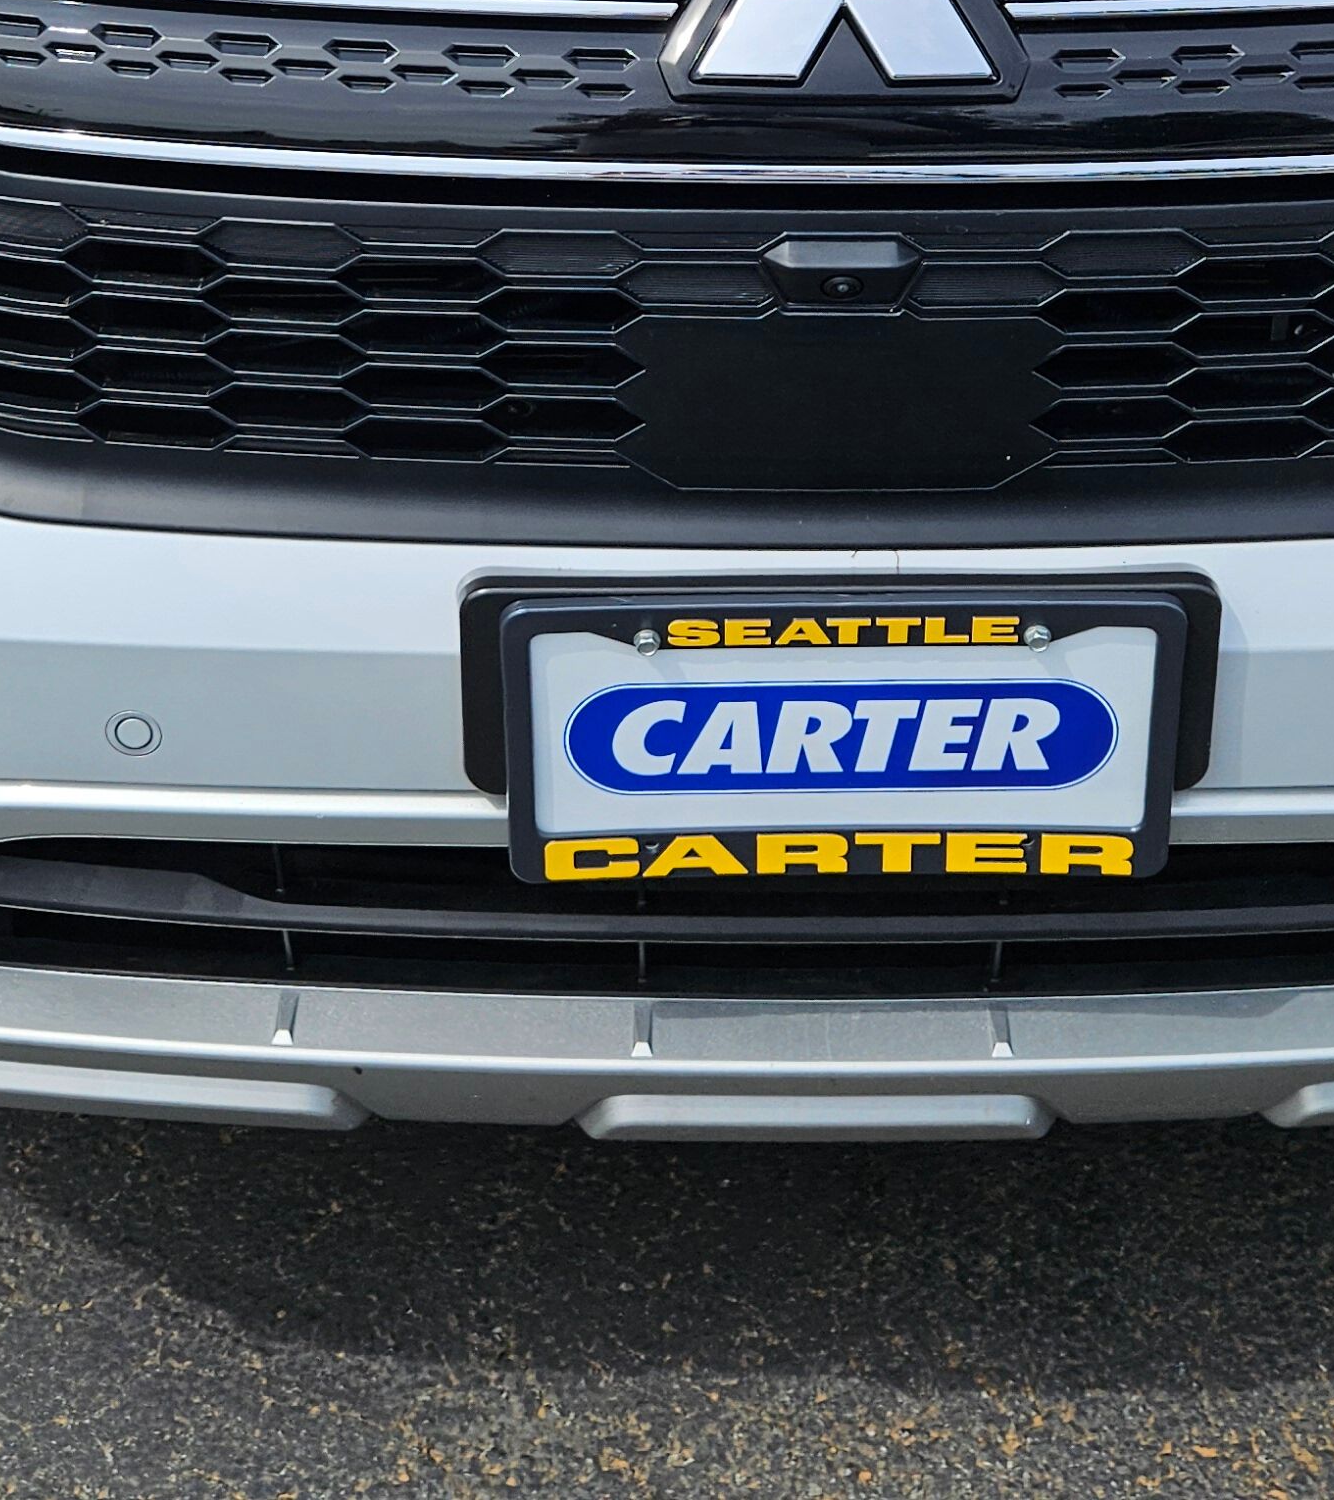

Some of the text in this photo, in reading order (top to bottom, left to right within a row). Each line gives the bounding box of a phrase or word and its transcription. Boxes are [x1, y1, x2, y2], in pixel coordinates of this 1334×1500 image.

[666, 615, 1022, 648] SEATTLE
[610, 696, 1062, 776] CARTER
[543, 831, 1136, 882] CARTER
